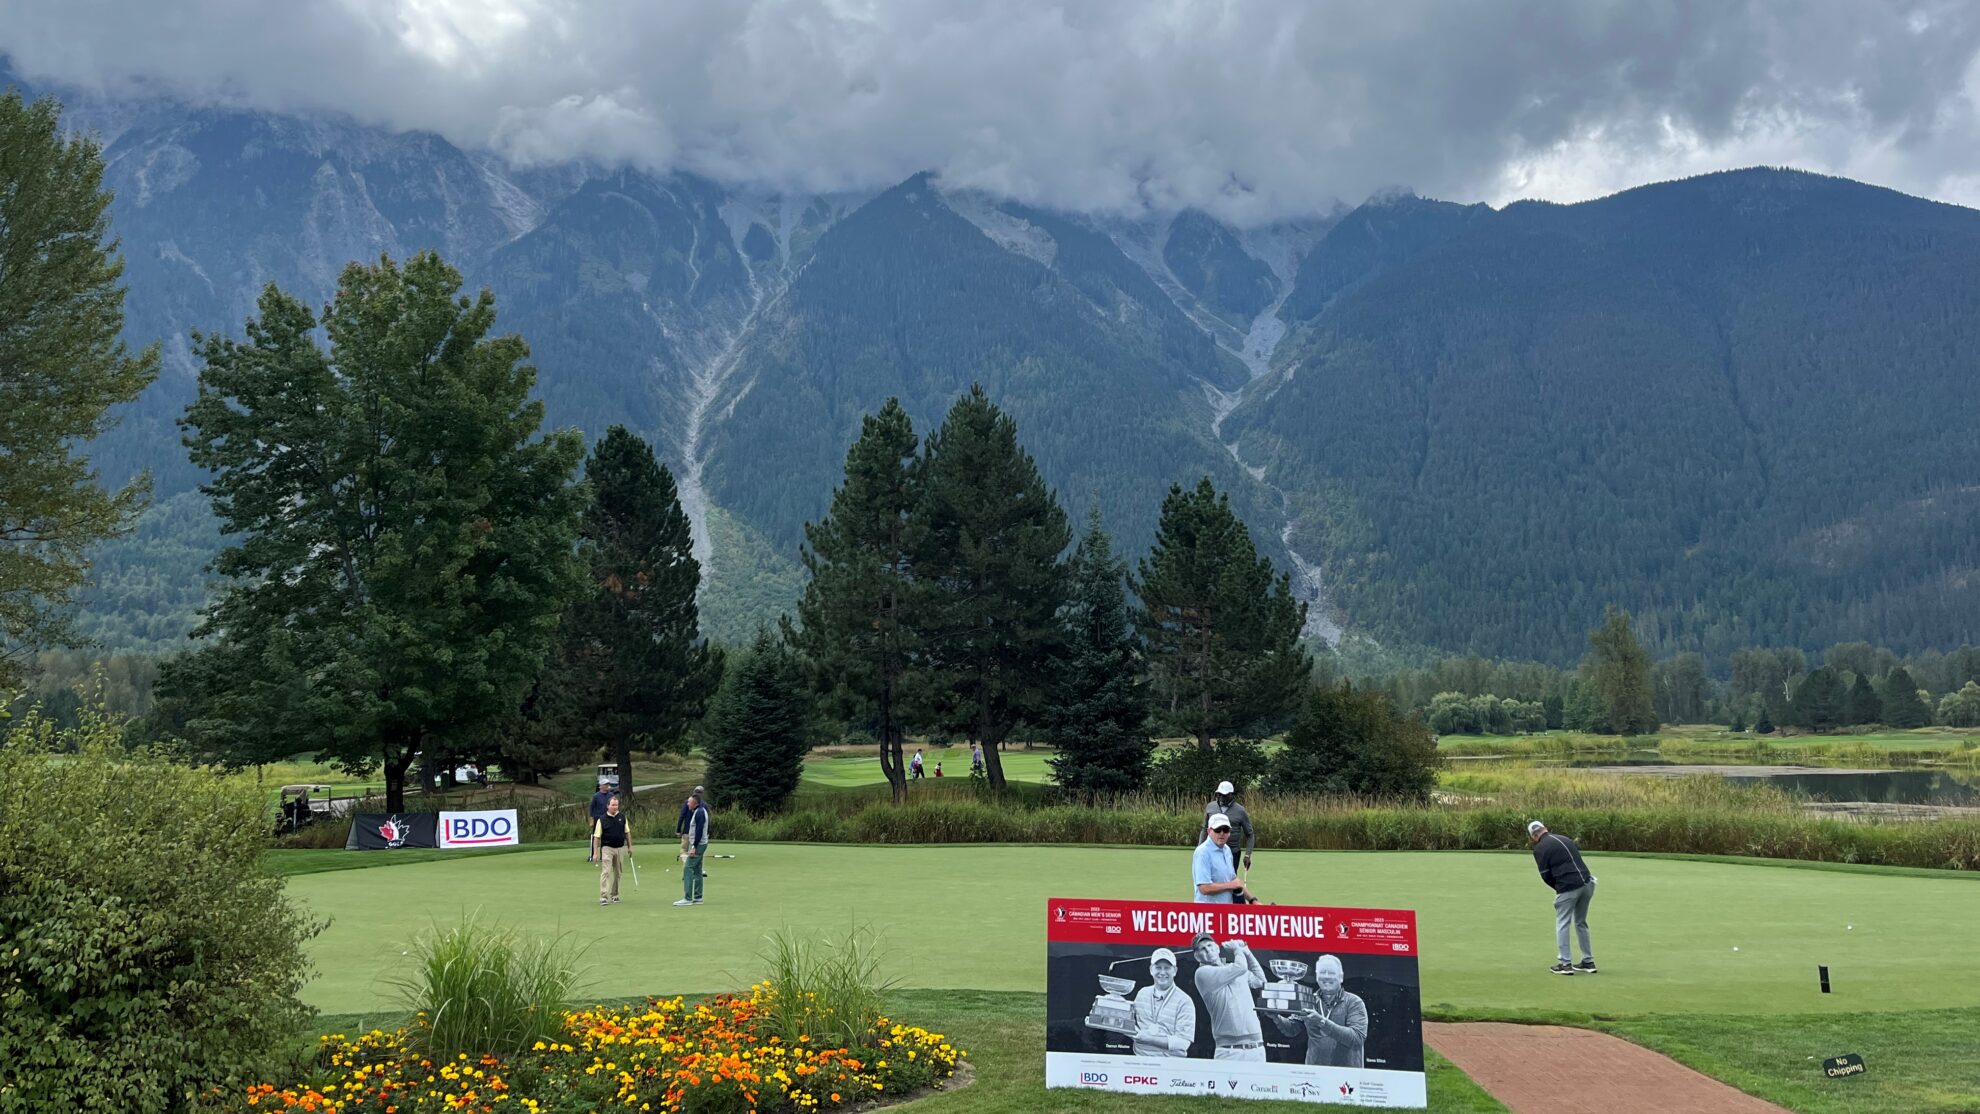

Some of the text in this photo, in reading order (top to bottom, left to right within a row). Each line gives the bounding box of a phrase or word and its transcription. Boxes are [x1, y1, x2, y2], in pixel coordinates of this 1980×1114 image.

[454, 817, 511, 838] BDO
[1131, 910, 1325, 938] WELCOME BIENVENUE
[1828, 1063, 1863, 1077] Chipping
[1084, 1072, 1108, 1083] BDO
[1124, 1075, 1158, 1085] CPKC
[1250, 1083, 1278, 1094] Canada
